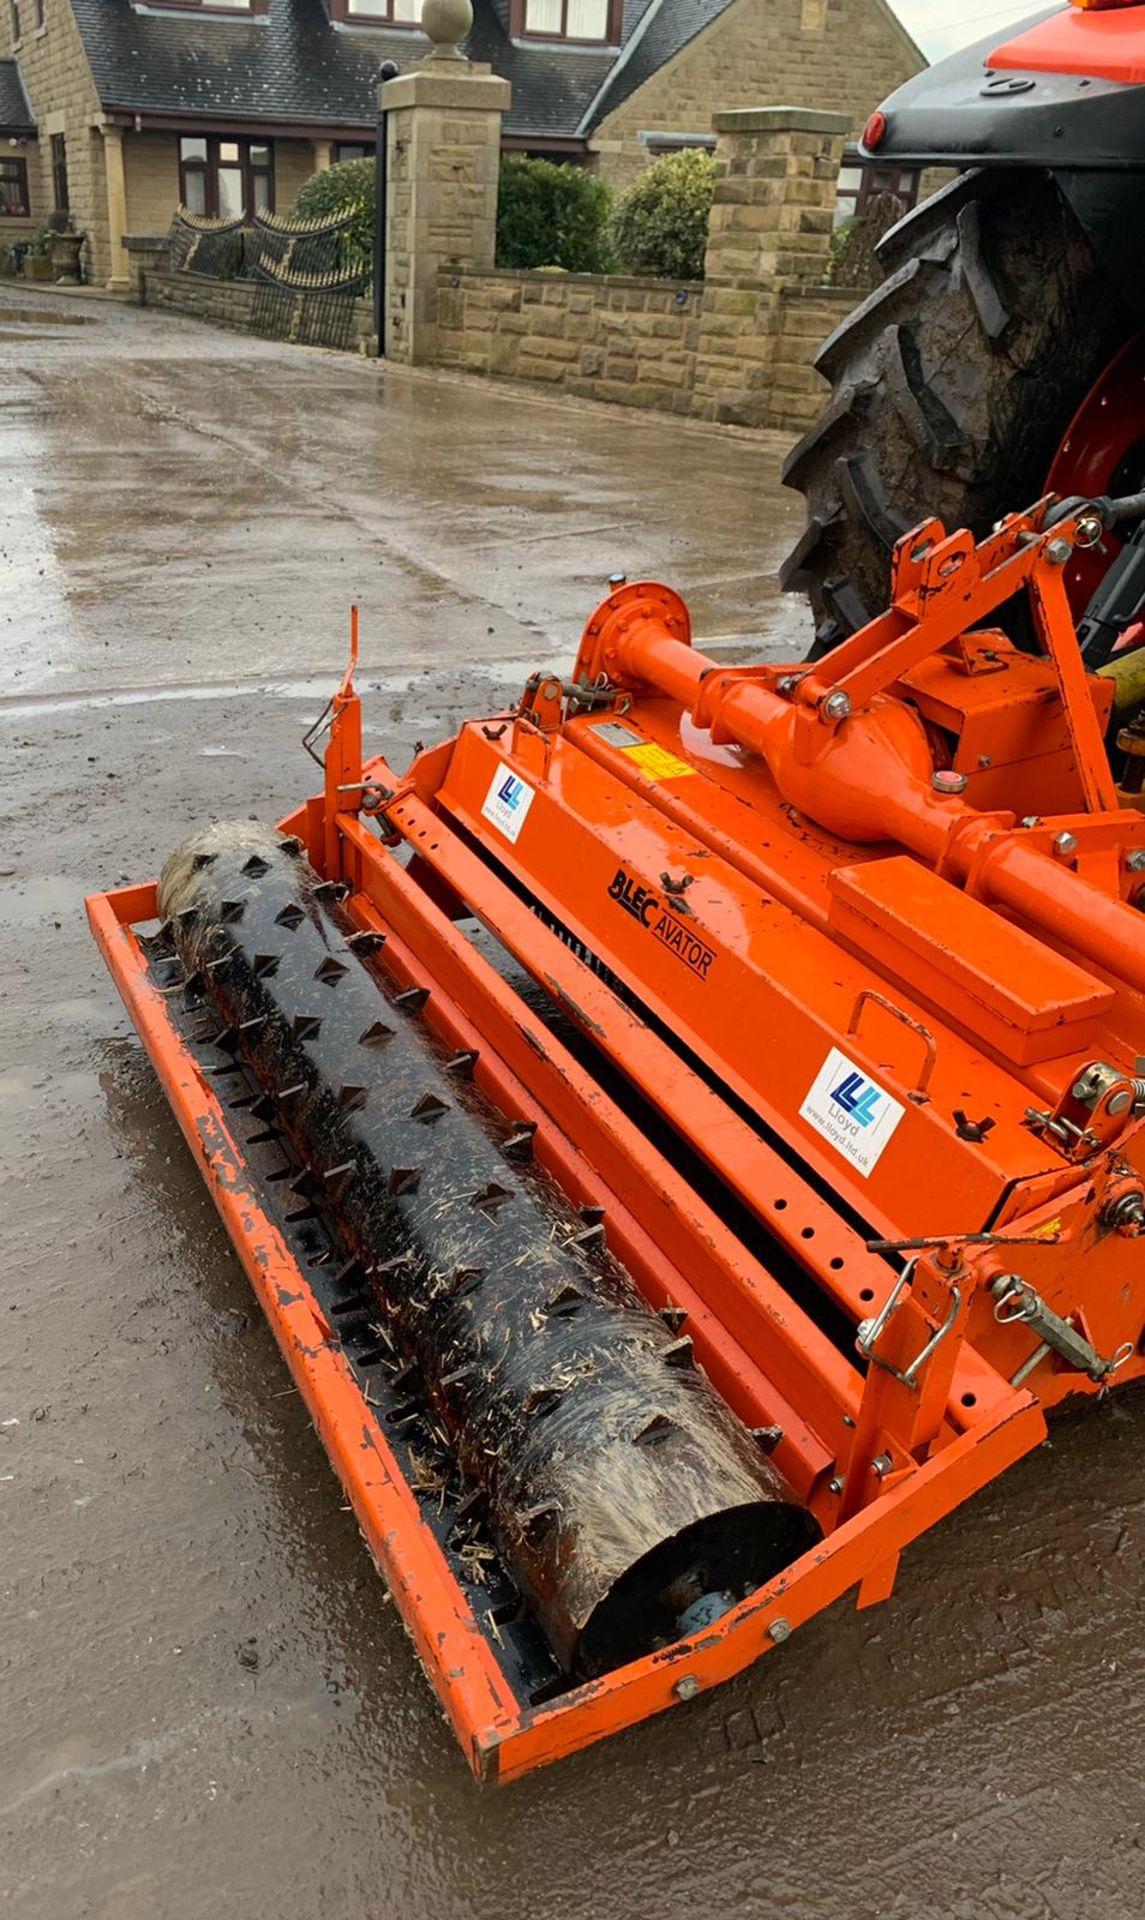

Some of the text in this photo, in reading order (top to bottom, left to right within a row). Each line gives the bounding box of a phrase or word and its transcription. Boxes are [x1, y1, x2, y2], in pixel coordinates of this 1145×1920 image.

[607, 868, 713, 976] BLEC AVATOR
[806, 1105, 869, 1166] www.lloyd.ltd.uk
[828, 1103, 860, 1137] Lloyd
